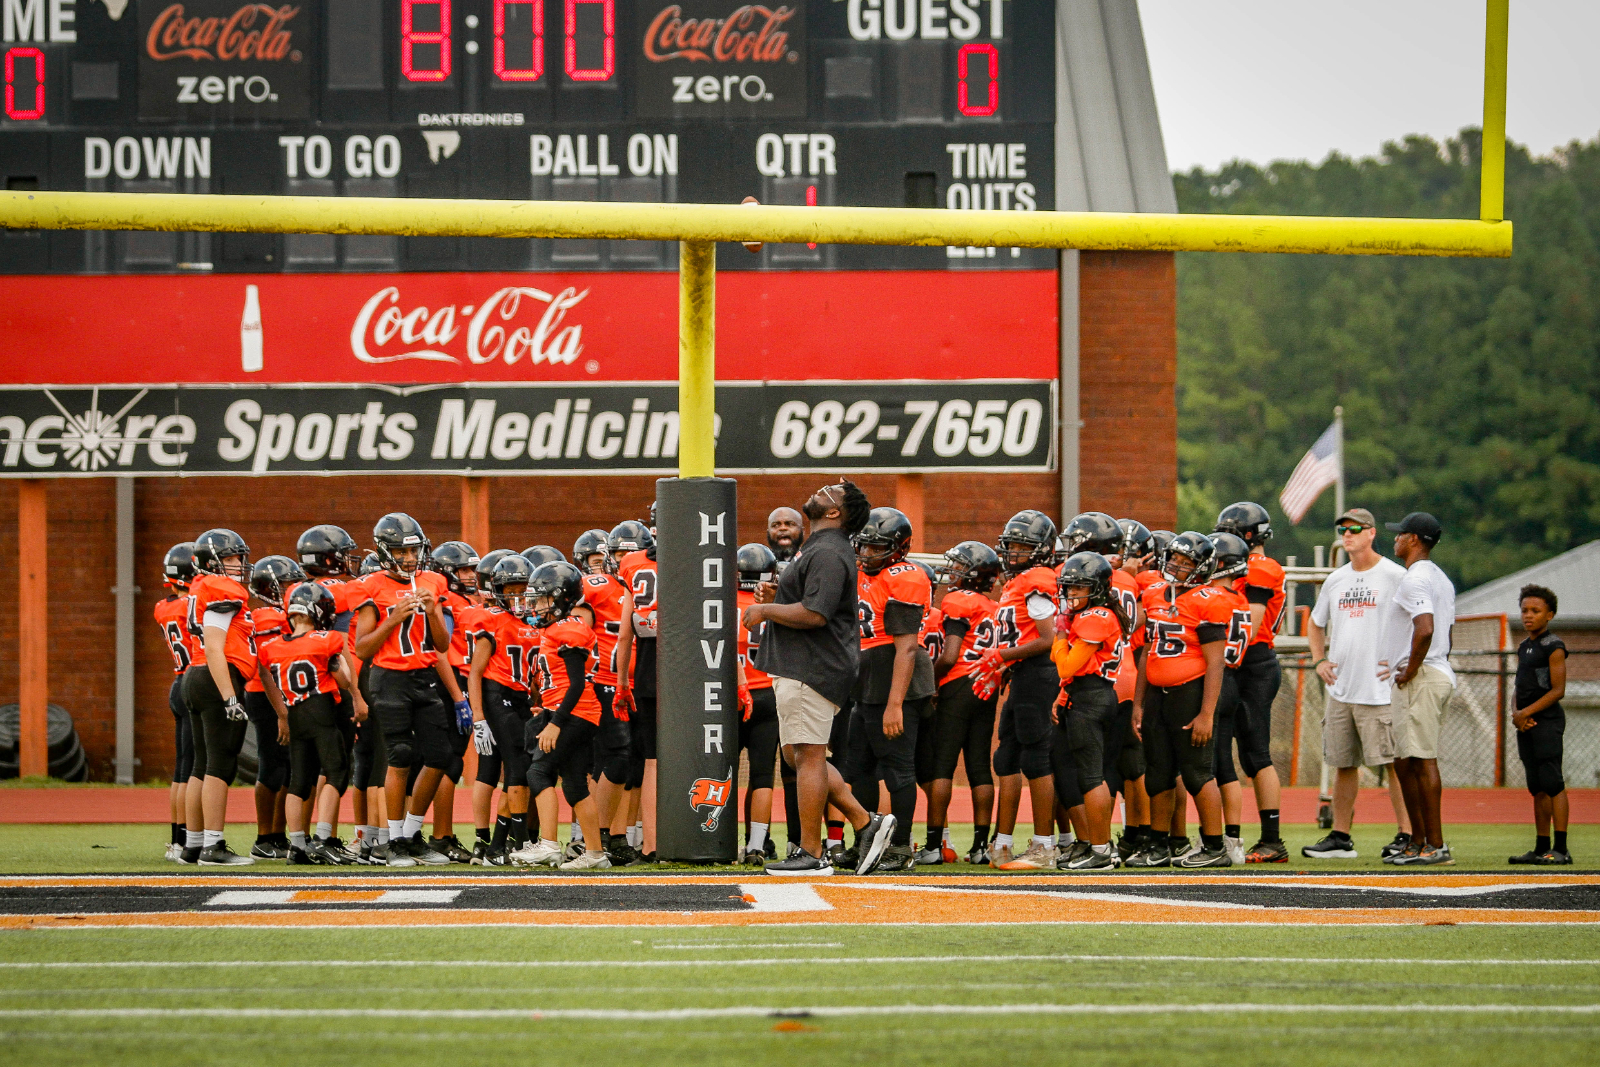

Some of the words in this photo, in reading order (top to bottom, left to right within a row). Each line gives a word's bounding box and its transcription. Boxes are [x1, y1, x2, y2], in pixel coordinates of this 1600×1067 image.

[146, 4, 300, 61] Coca-Cola
[643, 4, 797, 62] Coca-Cola
[846, 0, 1005, 41] GUEST
[5, 47, 45, 120] 0
[958, 43, 998, 116] 0
[418, 113, 525, 127] DAKTRONICS
[84, 136, 211, 179] DOWN
[279, 136, 332, 178] TO
[345, 135, 400, 178] GO
[530, 134, 619, 176] BALL
[628, 133, 678, 177] ON
[756, 133, 837, 178] QTR
[947, 143, 1026, 178] TIME
[947, 183, 1036, 211] OUTS
[351, 286, 591, 365] Coca-Cola
[217, 399, 418, 474] Sports
[431, 398, 722, 460] Medicin
[770, 398, 1044, 459] 682-7650
[1338, 597, 1377, 608] FOOTBALL
[699, 511, 725, 754] HOOVER
[270, 659, 322, 706] 10
